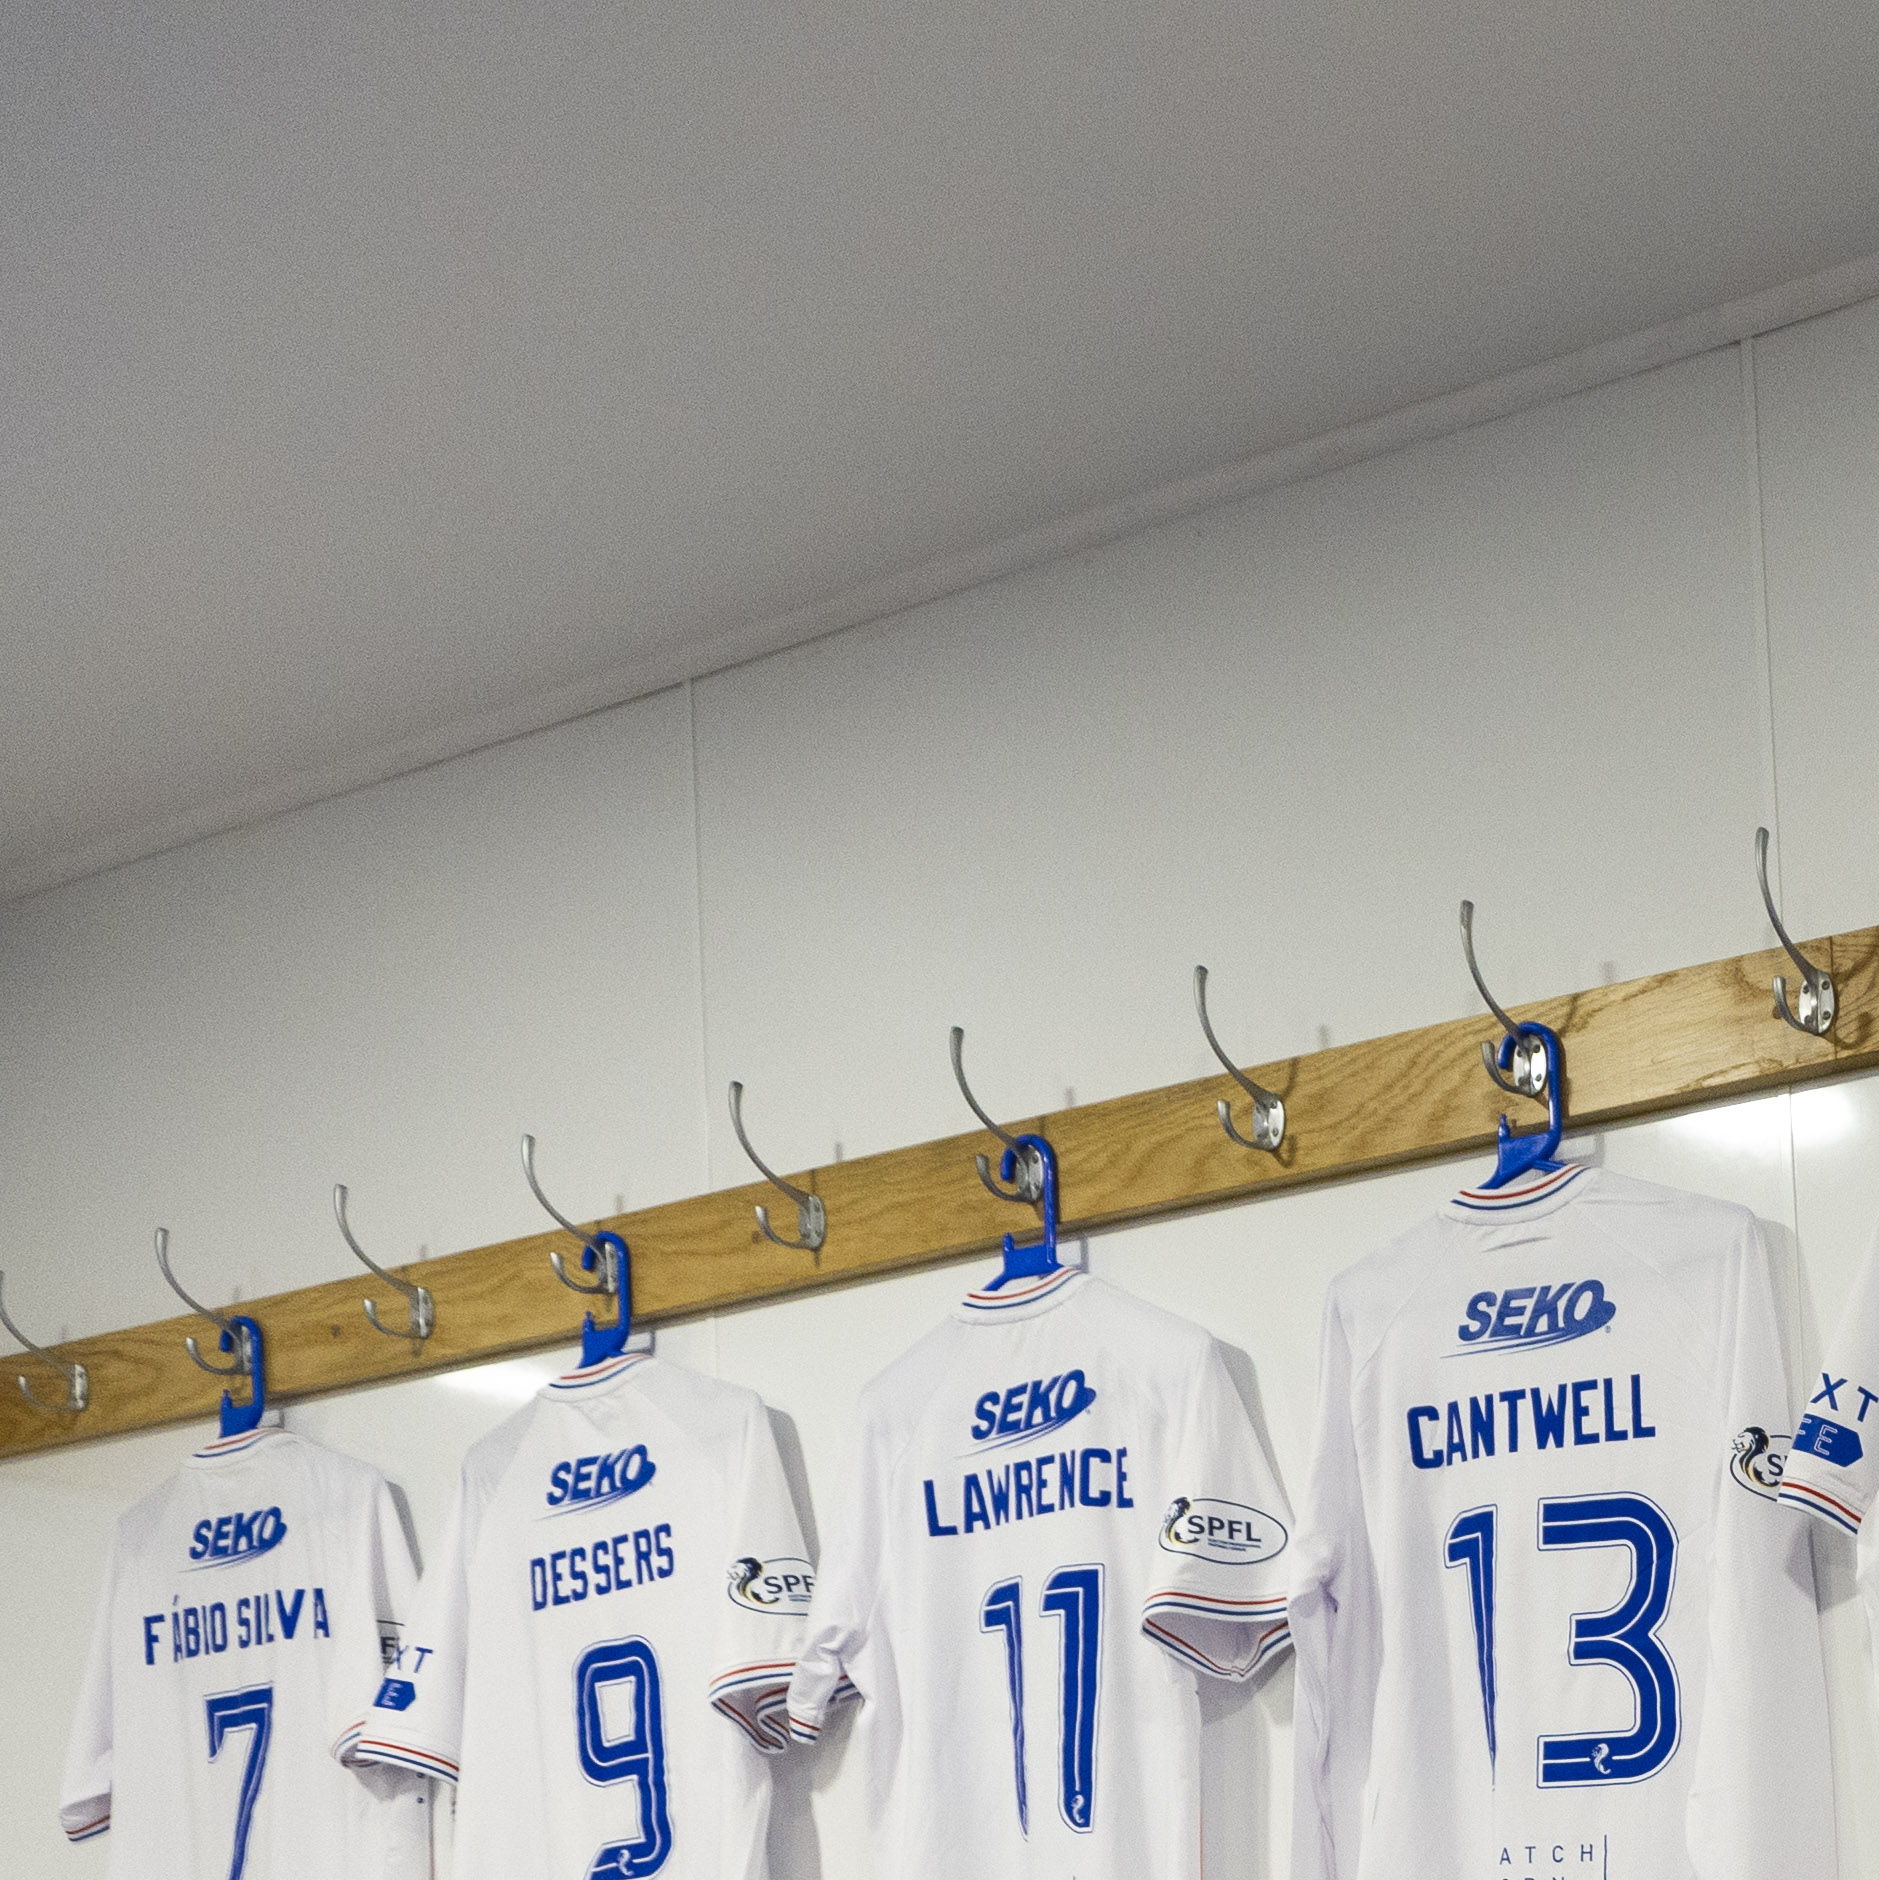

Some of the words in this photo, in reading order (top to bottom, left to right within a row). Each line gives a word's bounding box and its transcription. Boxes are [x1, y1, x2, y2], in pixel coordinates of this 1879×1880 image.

[1458, 1279, 1616, 1342] SEKO
[971, 1369, 1097, 1441] SEKO
[1406, 1373, 1656, 1469] CANTWELL
[1810, 1372, 1879, 1423] XT
[546, 1444, 656, 1506] SEKO
[923, 1446, 1134, 1538] LAWRENCE
[189, 1506, 288, 1560] SEKO
[1187, 1513, 1262, 1543] SPFL
[530, 1523, 674, 1611] DESSERS
[763, 1574, 815, 1594] SPF
[237, 1587, 330, 1649] SILVA
[1442, 1492, 1682, 1790] 13
[979, 1562, 1106, 1841] 11
[1500, 1844, 1593, 1865] ATCH
